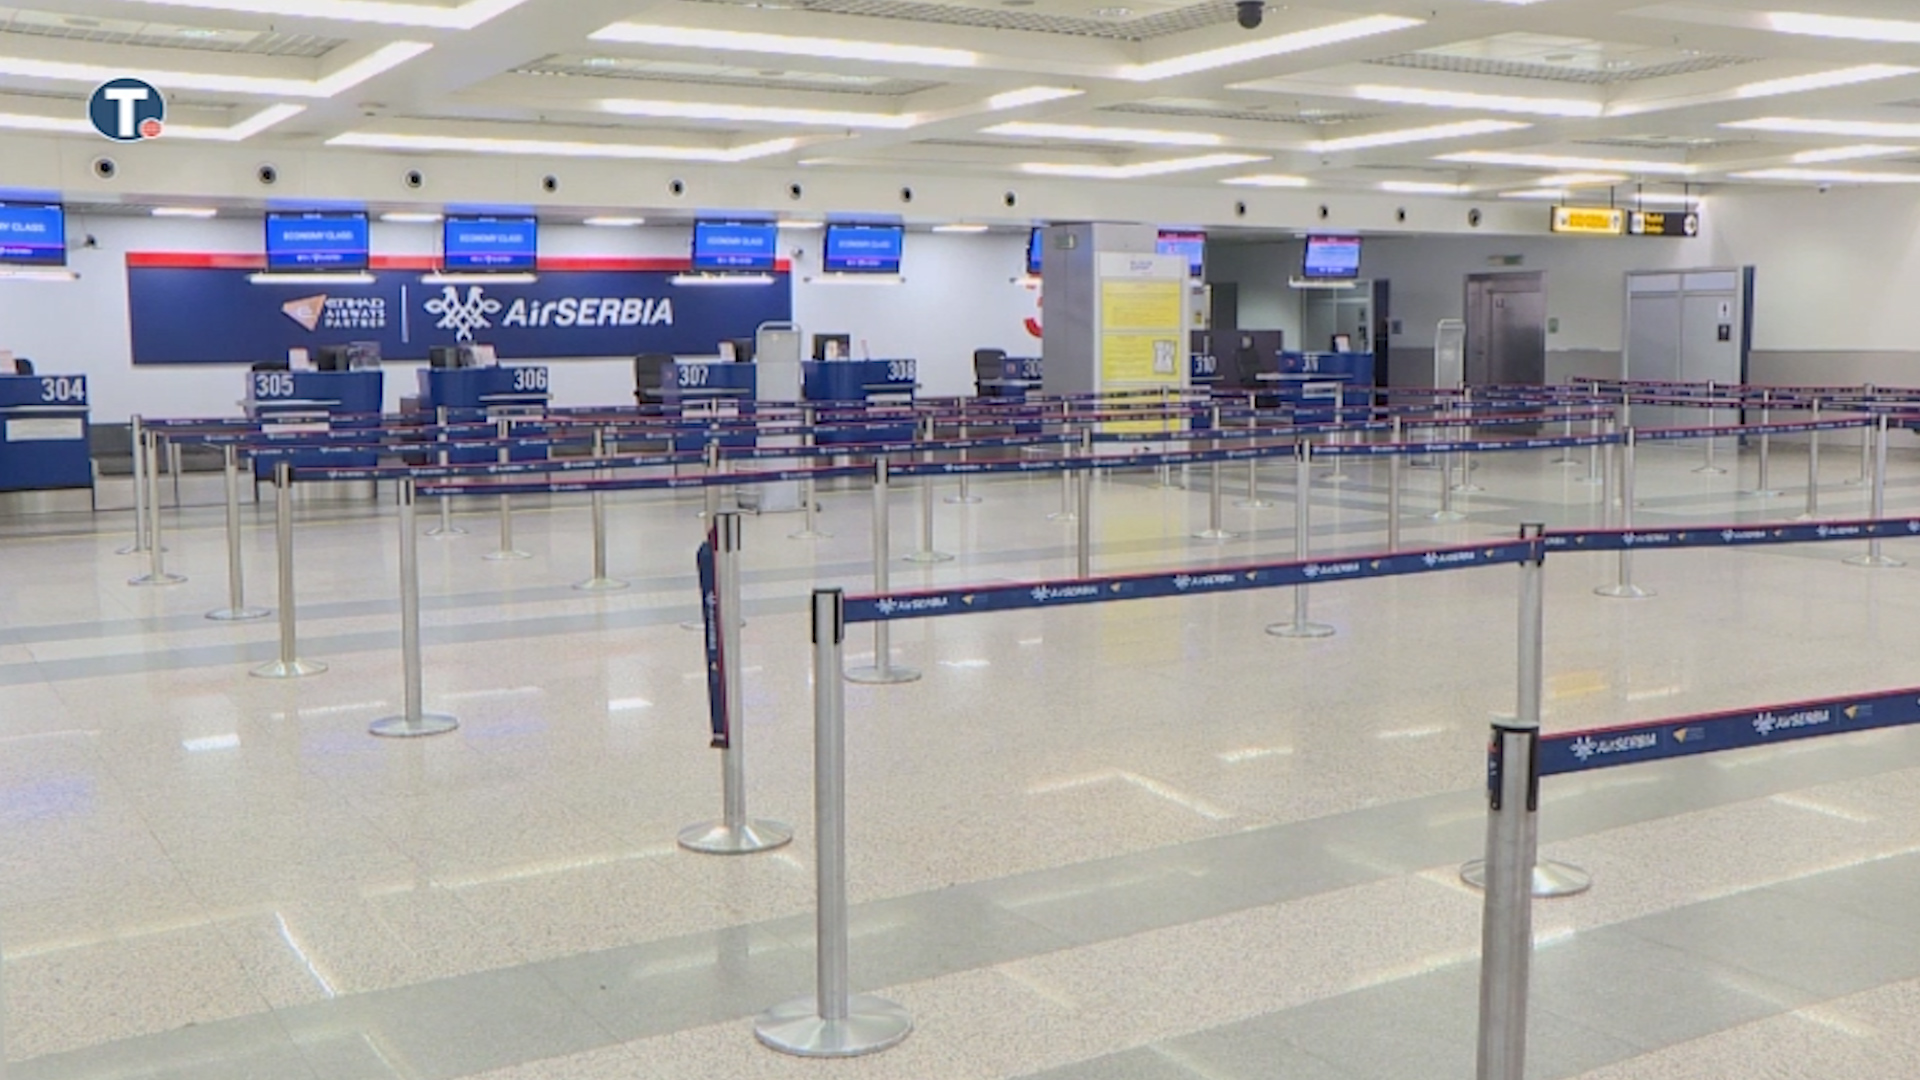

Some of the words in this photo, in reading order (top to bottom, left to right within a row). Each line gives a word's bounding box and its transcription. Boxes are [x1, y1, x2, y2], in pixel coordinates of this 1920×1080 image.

[325, 309, 385, 318] AIRWAYS
[501, 297, 674, 327] AirSERBIA
[325, 319, 385, 328] PARTNER
[255, 374, 295, 397] 305
[514, 368, 547, 390] 306
[679, 365, 709, 386] 307
[41, 378, 84, 401] 304
